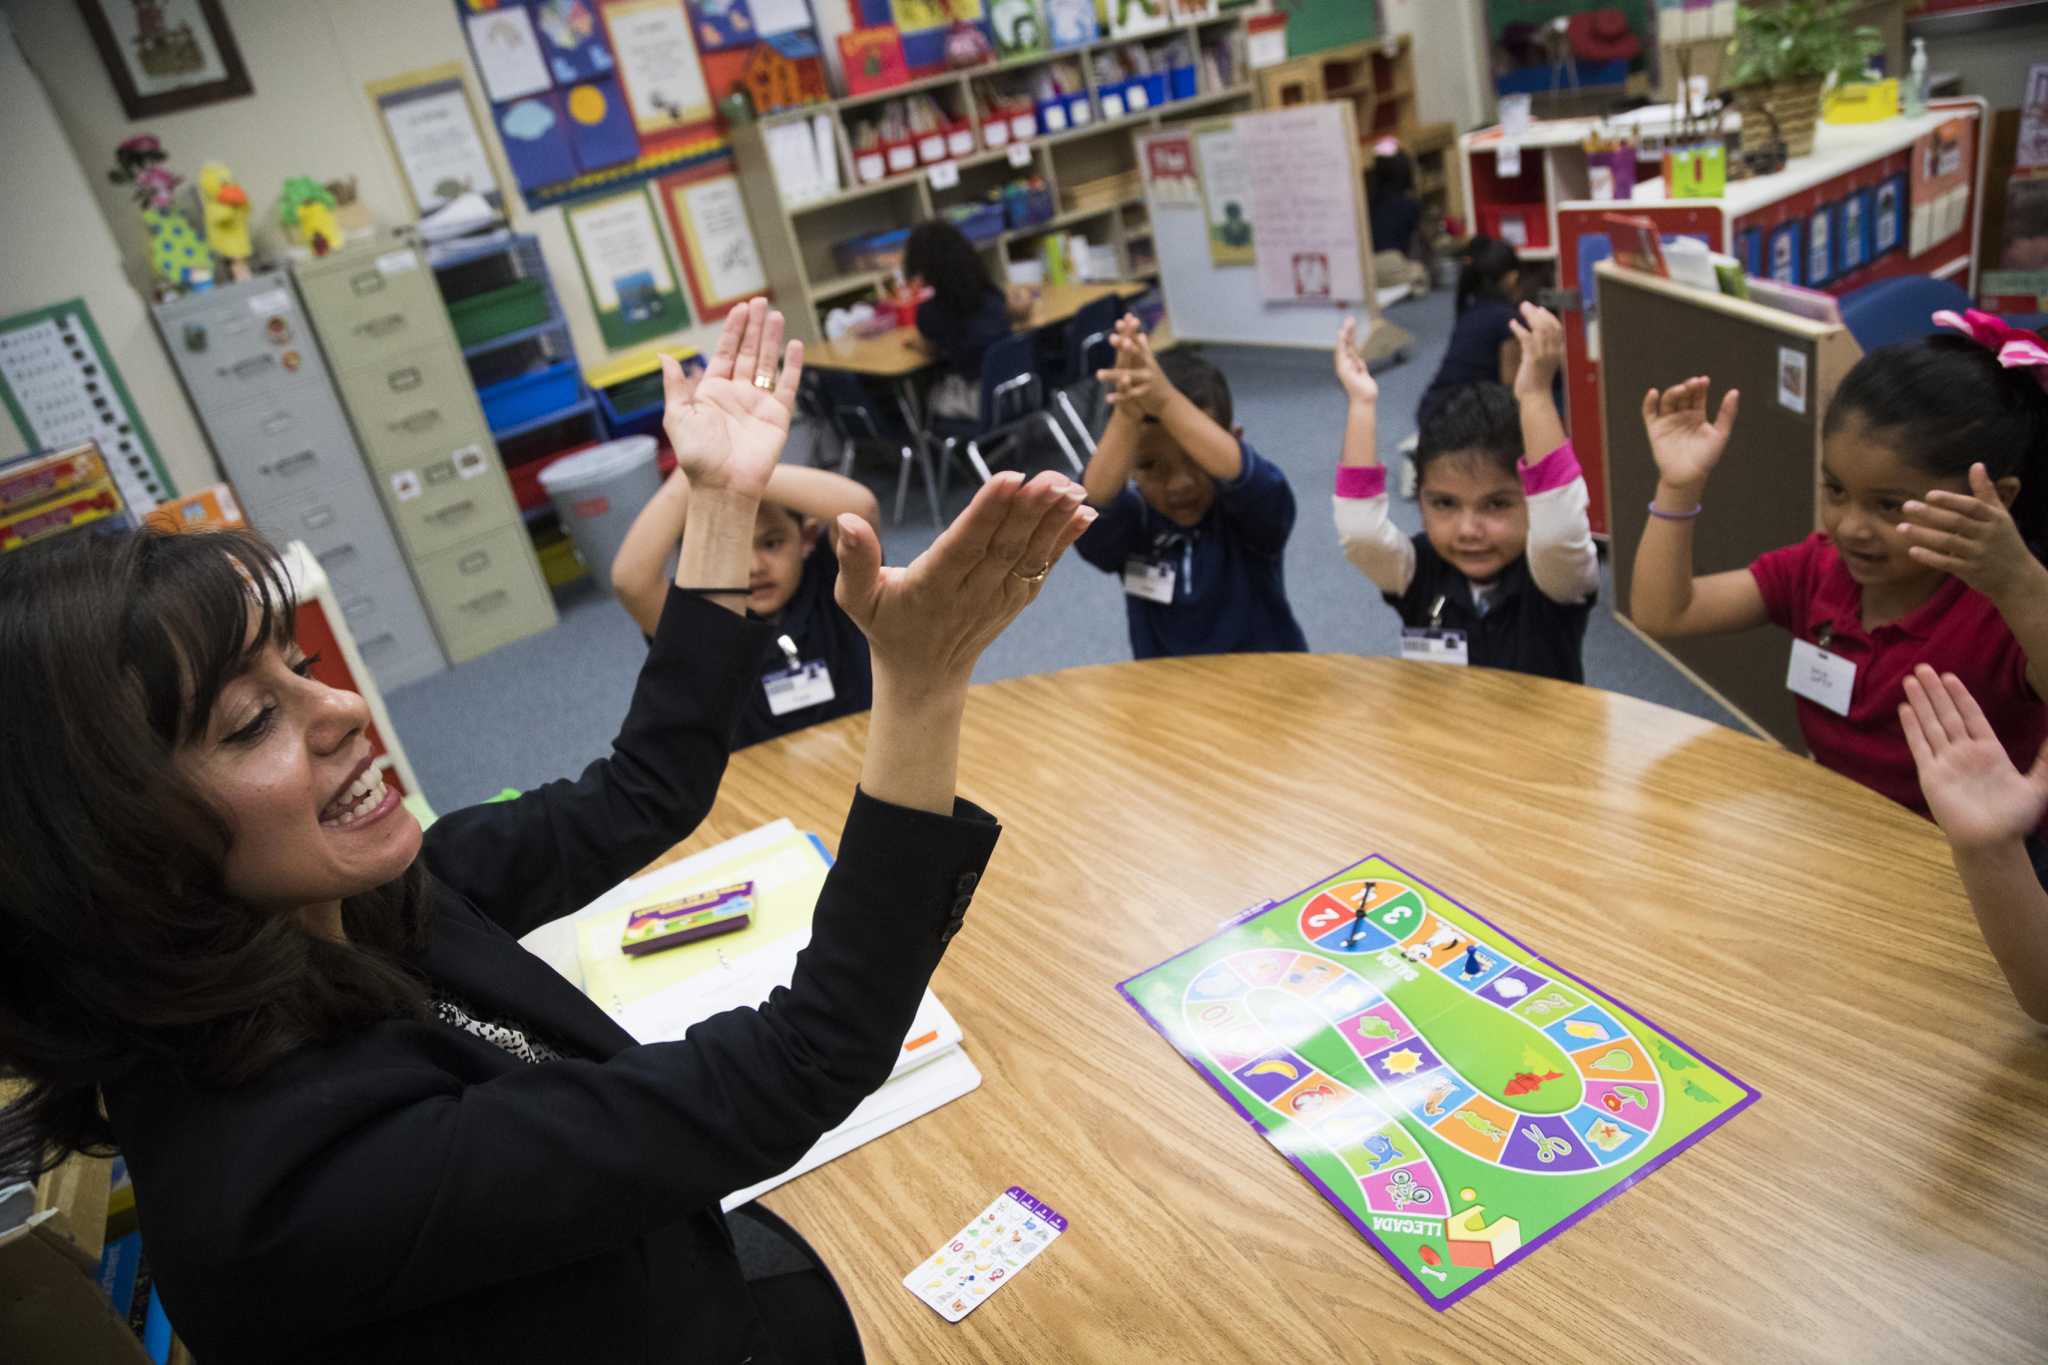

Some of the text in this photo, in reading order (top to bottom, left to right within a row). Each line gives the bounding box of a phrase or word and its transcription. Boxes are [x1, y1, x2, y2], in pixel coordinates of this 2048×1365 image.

[1308, 908, 1340, 927] 2
[1382, 905, 1413, 924] 3
[1373, 1216, 1442, 1236] LLEGADA
